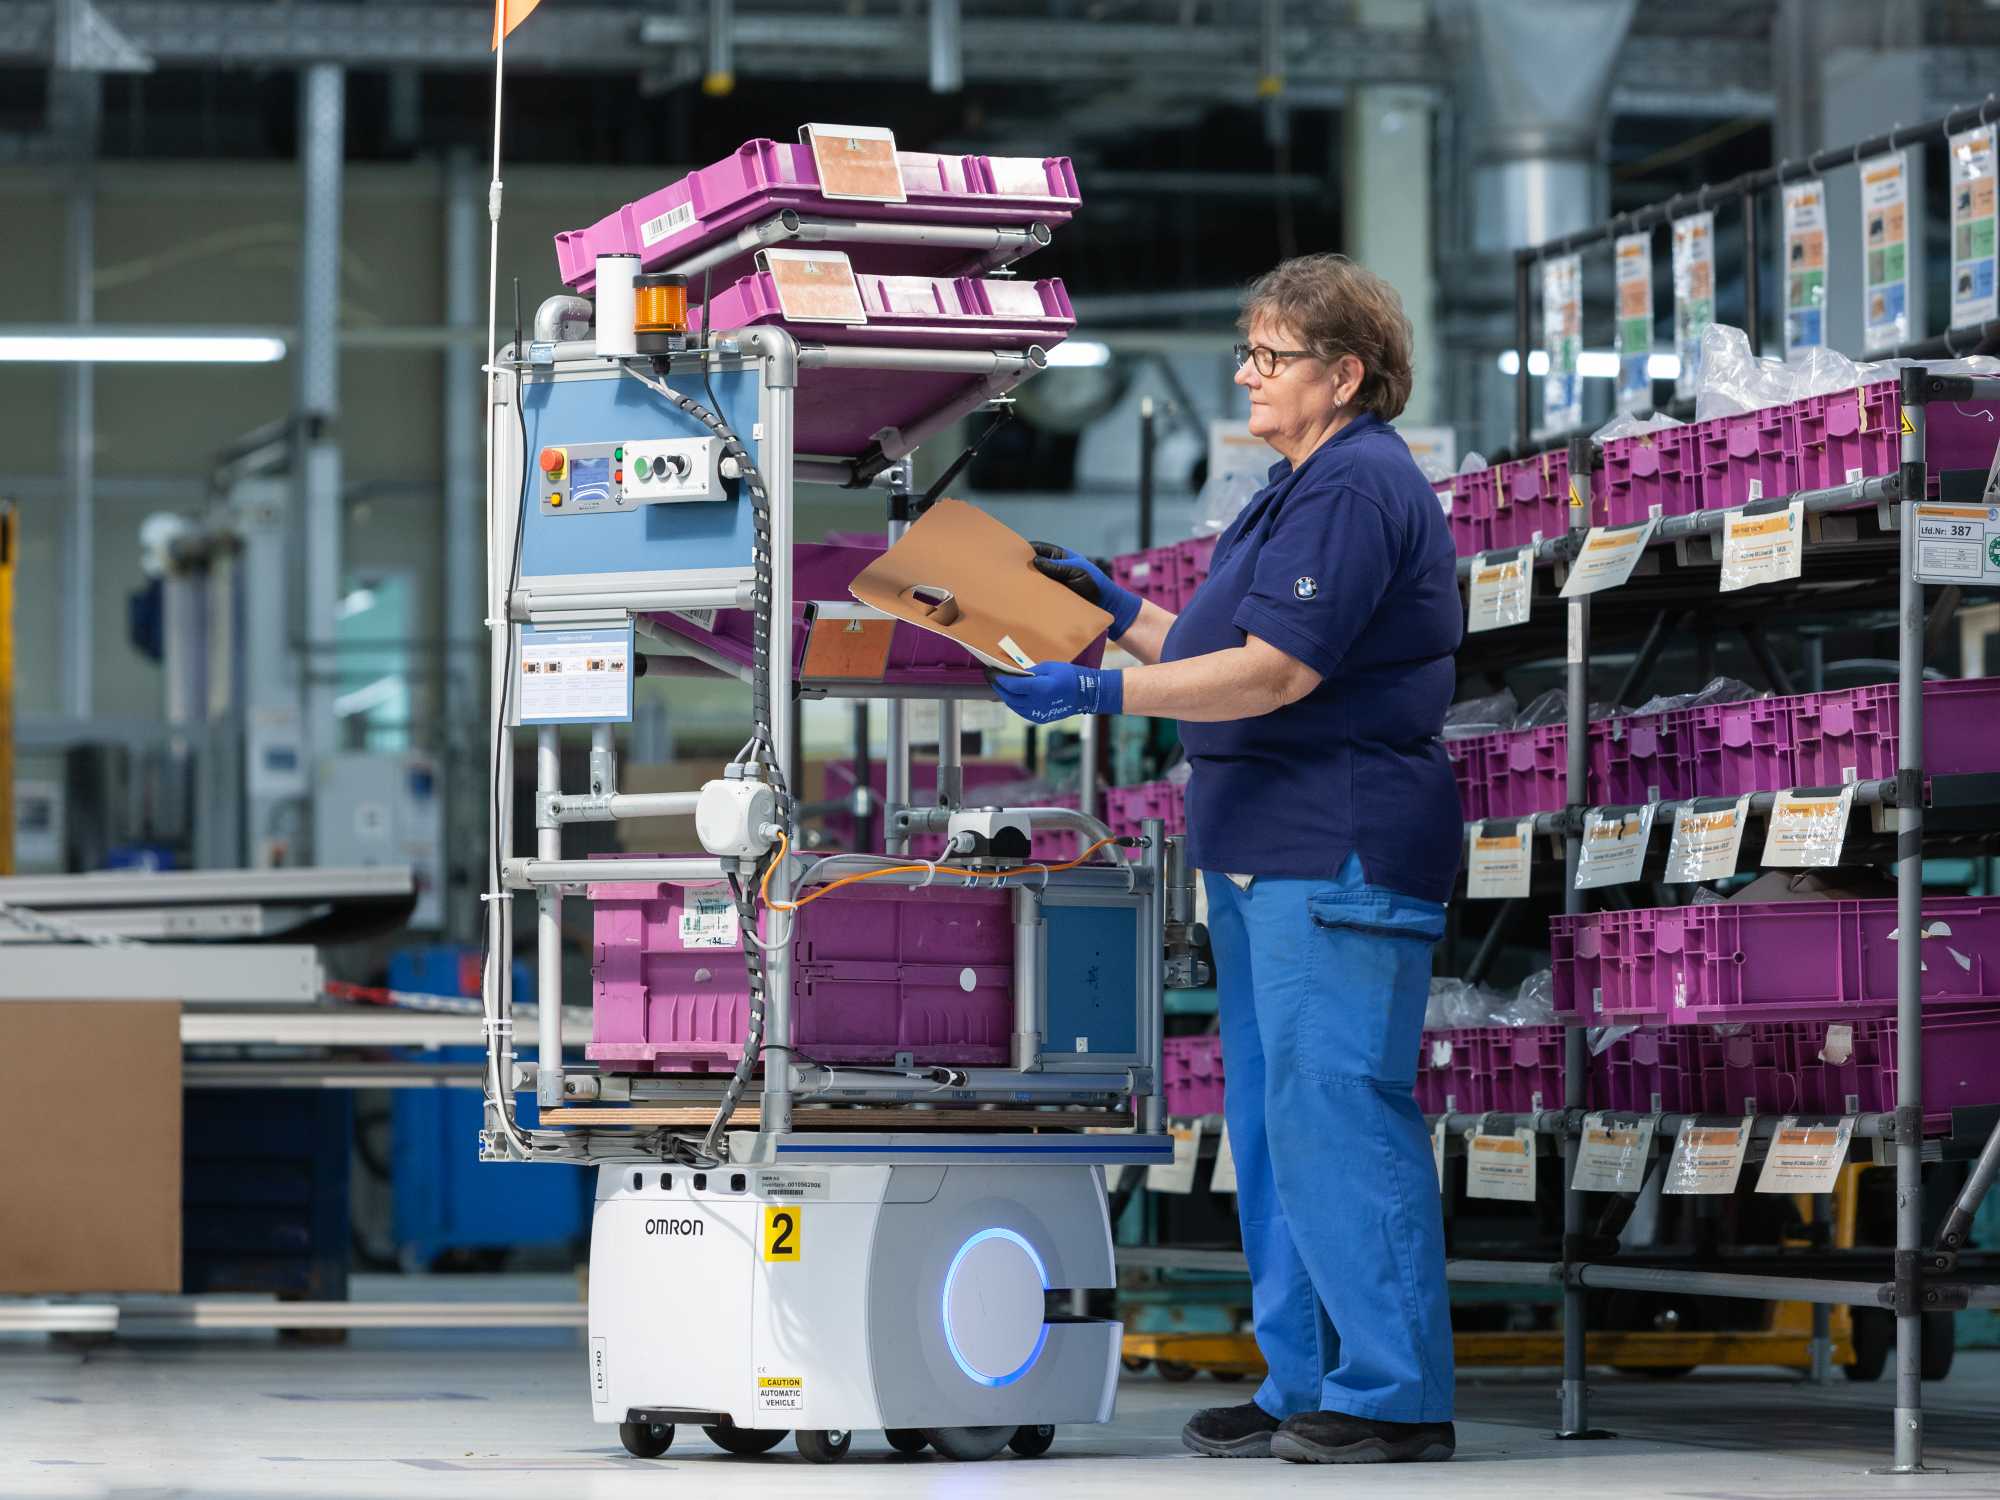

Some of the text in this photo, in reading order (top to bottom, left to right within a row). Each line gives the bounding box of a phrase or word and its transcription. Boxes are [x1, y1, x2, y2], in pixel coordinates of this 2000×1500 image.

[1950, 525, 1972, 537] 387
[645, 1219, 704, 1236] OMRON
[771, 1212, 794, 1255] 2
[760, 1389, 801, 1397] AUTOMATIC
[766, 1399, 796, 1407] VEHICLE
